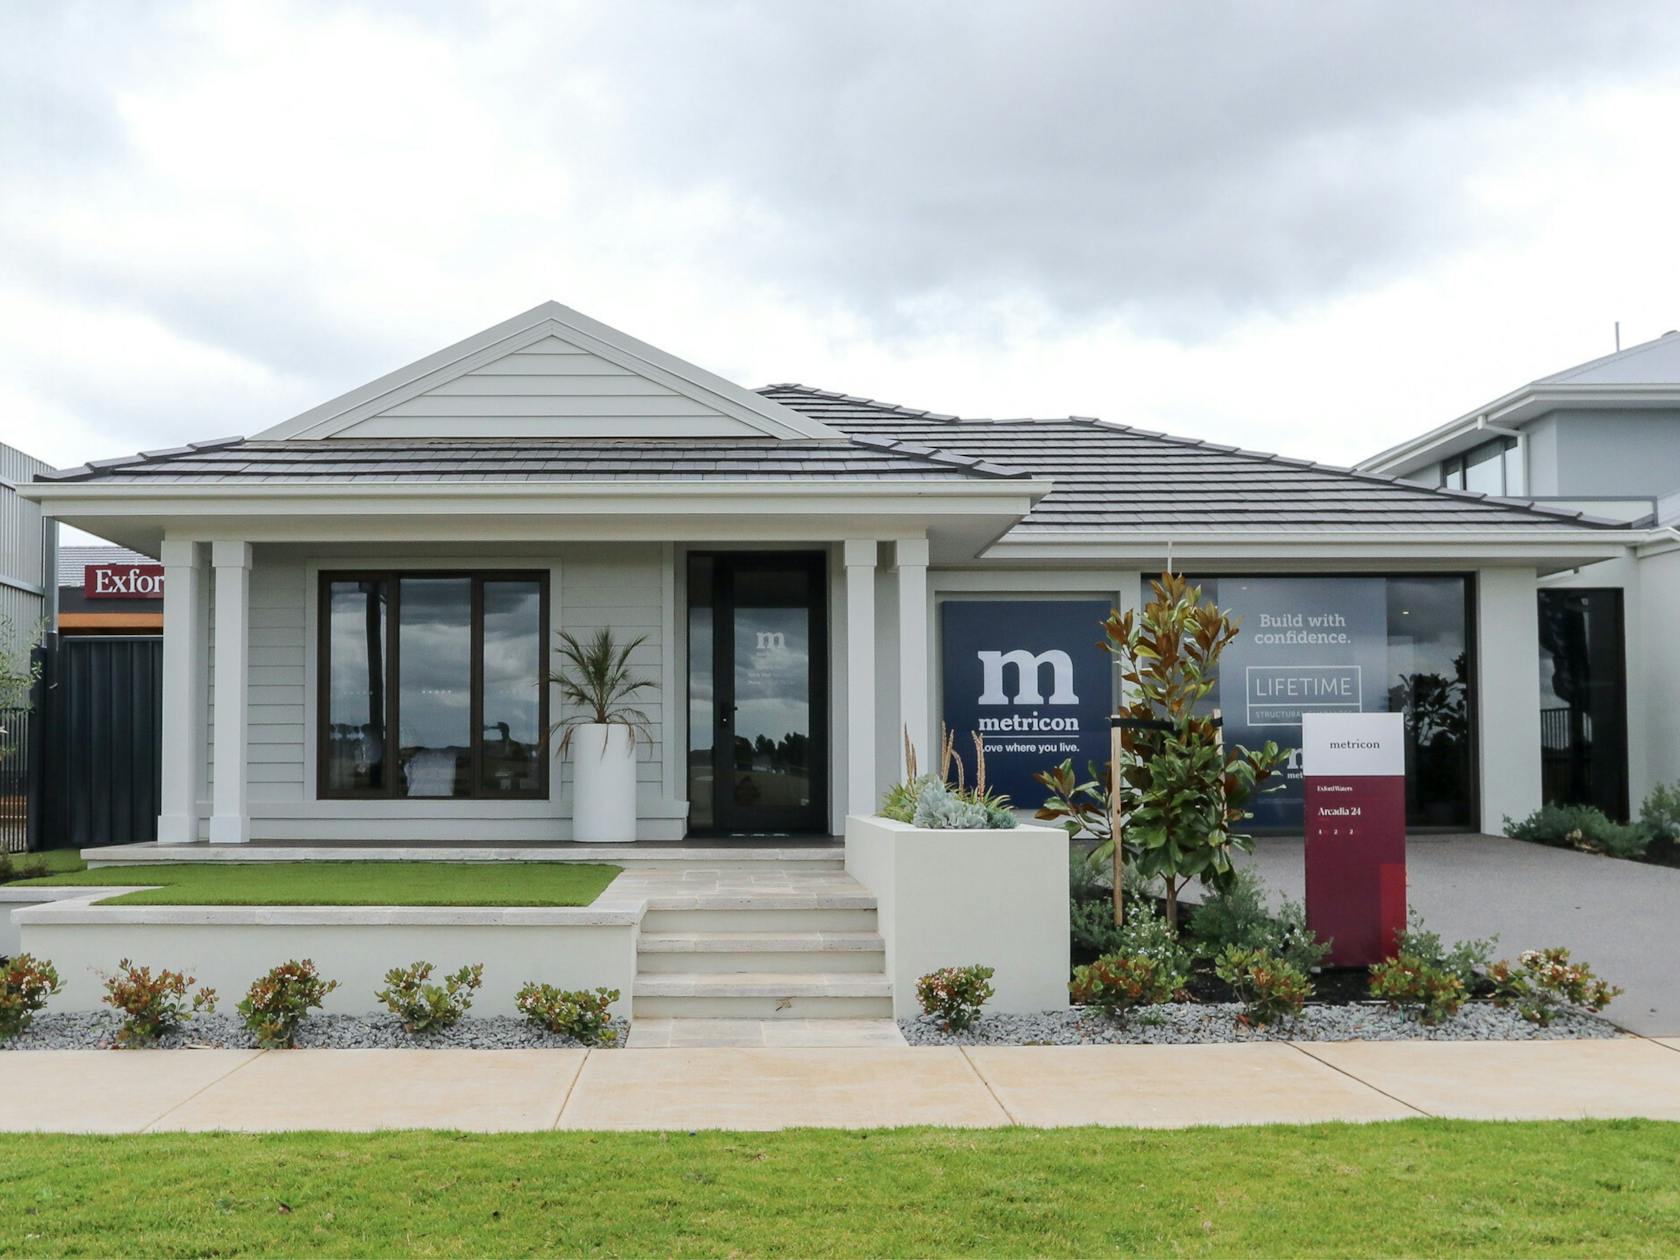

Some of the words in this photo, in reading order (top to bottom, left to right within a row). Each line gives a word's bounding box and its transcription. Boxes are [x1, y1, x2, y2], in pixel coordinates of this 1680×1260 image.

[95, 568, 165, 593] Exfor
[1259, 614, 1303, 627] Build
[1307, 614, 1346, 627] with
[755, 632, 786, 649] m
[1254, 630, 1352, 644] confidence.
[978, 649, 1080, 705] m
[1256, 677, 1352, 696] LIFETIME
[978, 711, 1080, 731] metricon
[1255, 711, 1303, 719] STRUCTURA
[982, 744, 1003, 752] ove
[1005, 742, 1036, 752] where
[1038, 744, 1057, 754] you
[1059, 742, 1080, 752] live.
[1330, 739, 1380, 749] metricon
[1318, 807, 1349, 816] Arcadia
[1350, 807, 1361, 816] 24
